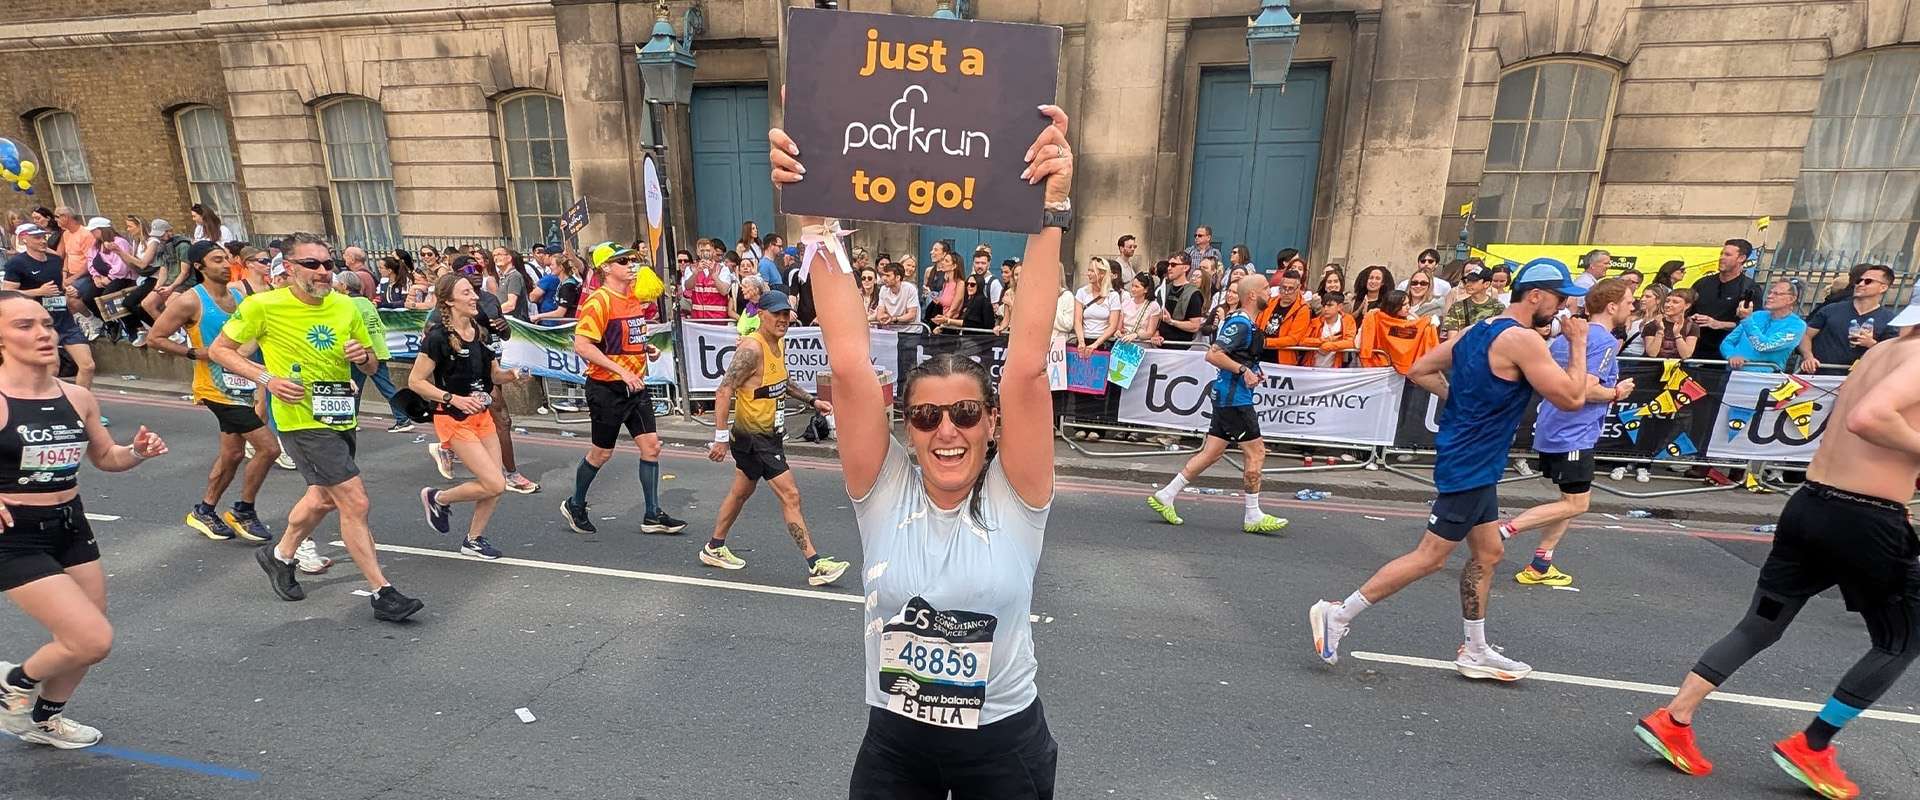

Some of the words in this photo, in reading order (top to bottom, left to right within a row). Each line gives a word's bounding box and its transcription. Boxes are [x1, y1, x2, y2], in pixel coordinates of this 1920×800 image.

[859, 28, 947, 77] just
[959, 47, 985, 76] a
[842, 84, 991, 158] parkrun
[851, 170, 896, 203] to
[907, 177, 976, 215] go!
[313, 383, 332, 396] tcs
[320, 400, 352, 412] 58089
[1252, 392, 1370, 410] ONSULTANCY
[1257, 408, 1317, 426] RVICES
[20, 428, 53, 443] tcs
[36, 446, 82, 466] 19475
[903, 606, 931, 630] cs
[934, 615, 989, 631] CONSULTANCY
[898, 641, 978, 679] 48859
[918, 694, 940, 704] new
[940, 694, 981, 706] balance
[902, 697, 964, 726] BELLA
